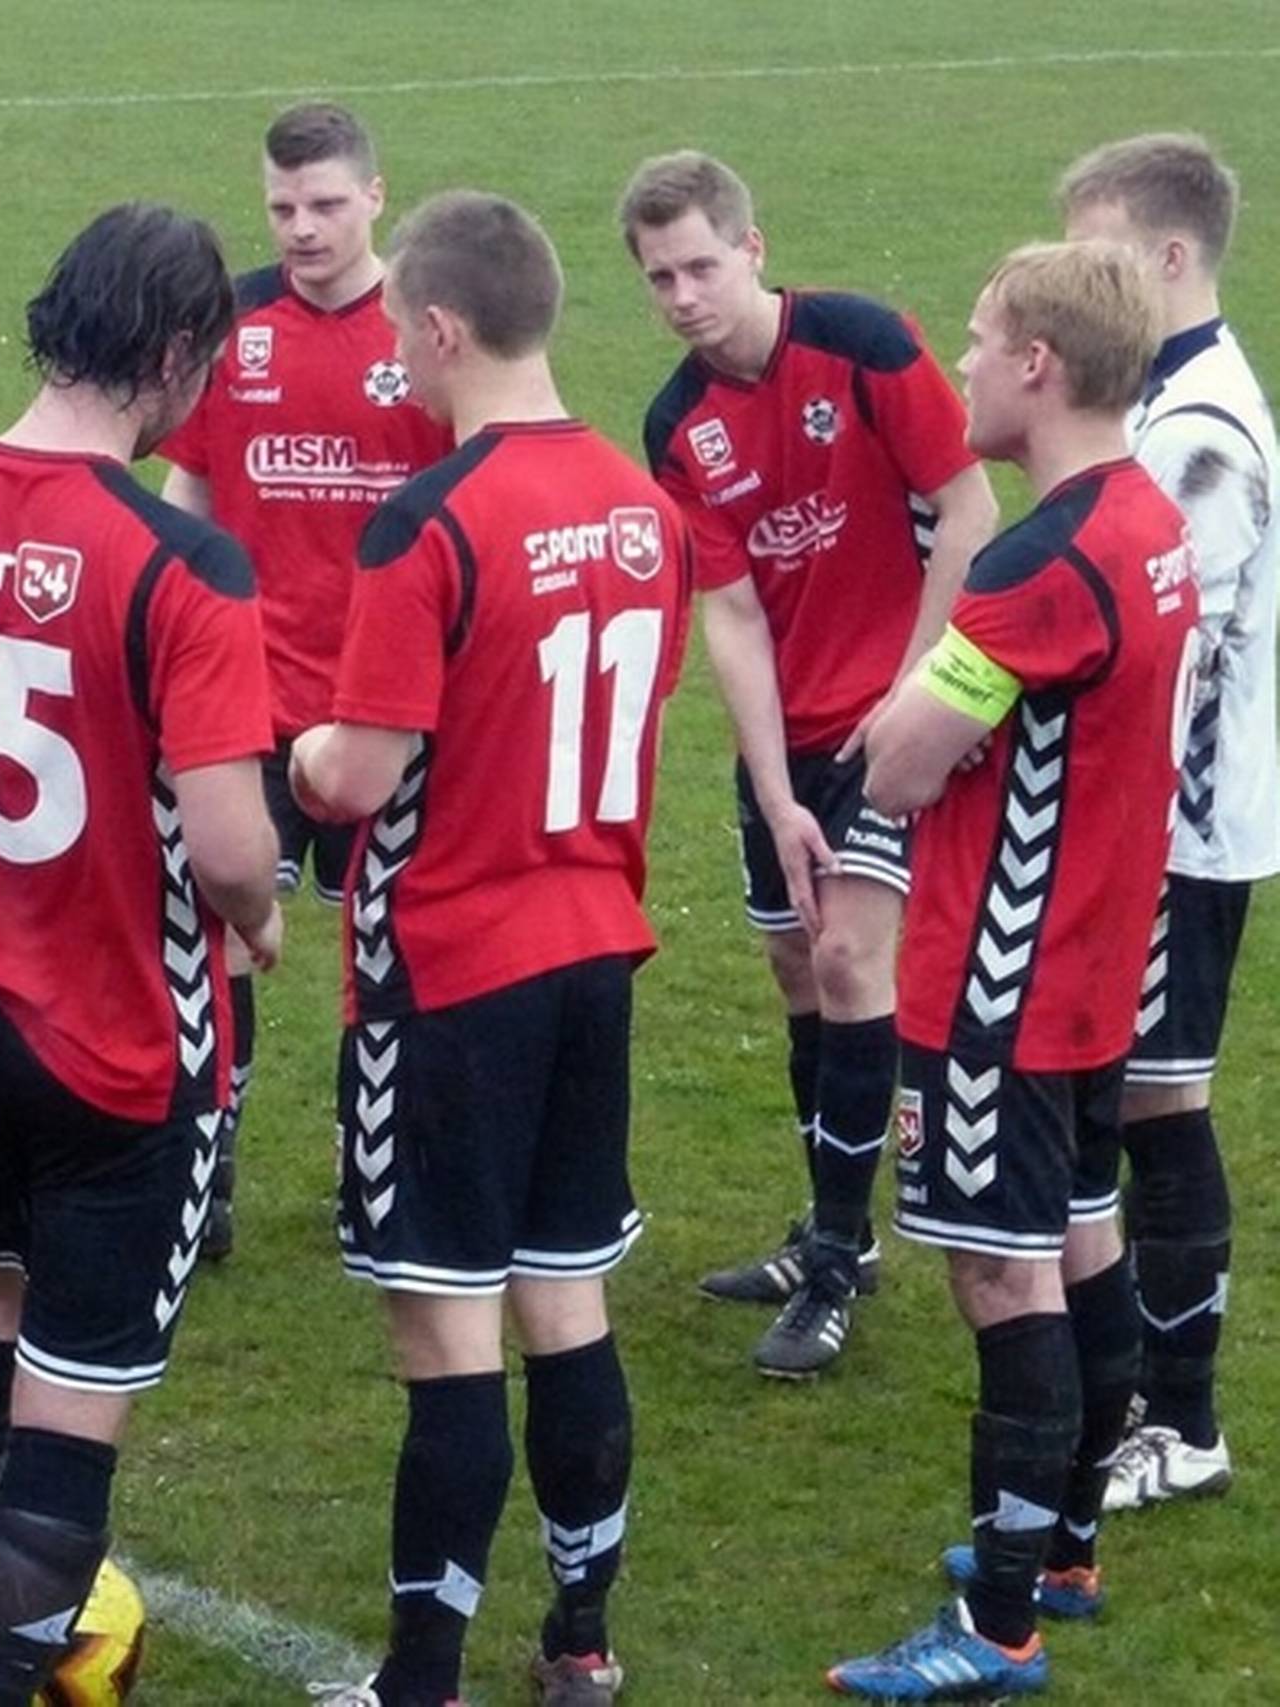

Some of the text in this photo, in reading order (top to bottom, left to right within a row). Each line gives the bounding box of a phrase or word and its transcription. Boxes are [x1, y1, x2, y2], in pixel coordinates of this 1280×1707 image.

[267, 437, 354, 469] HSM
[523, 521, 660, 571] SPORT 24
[22, 558, 68, 602] 24
[537, 608, 663, 832] 11
